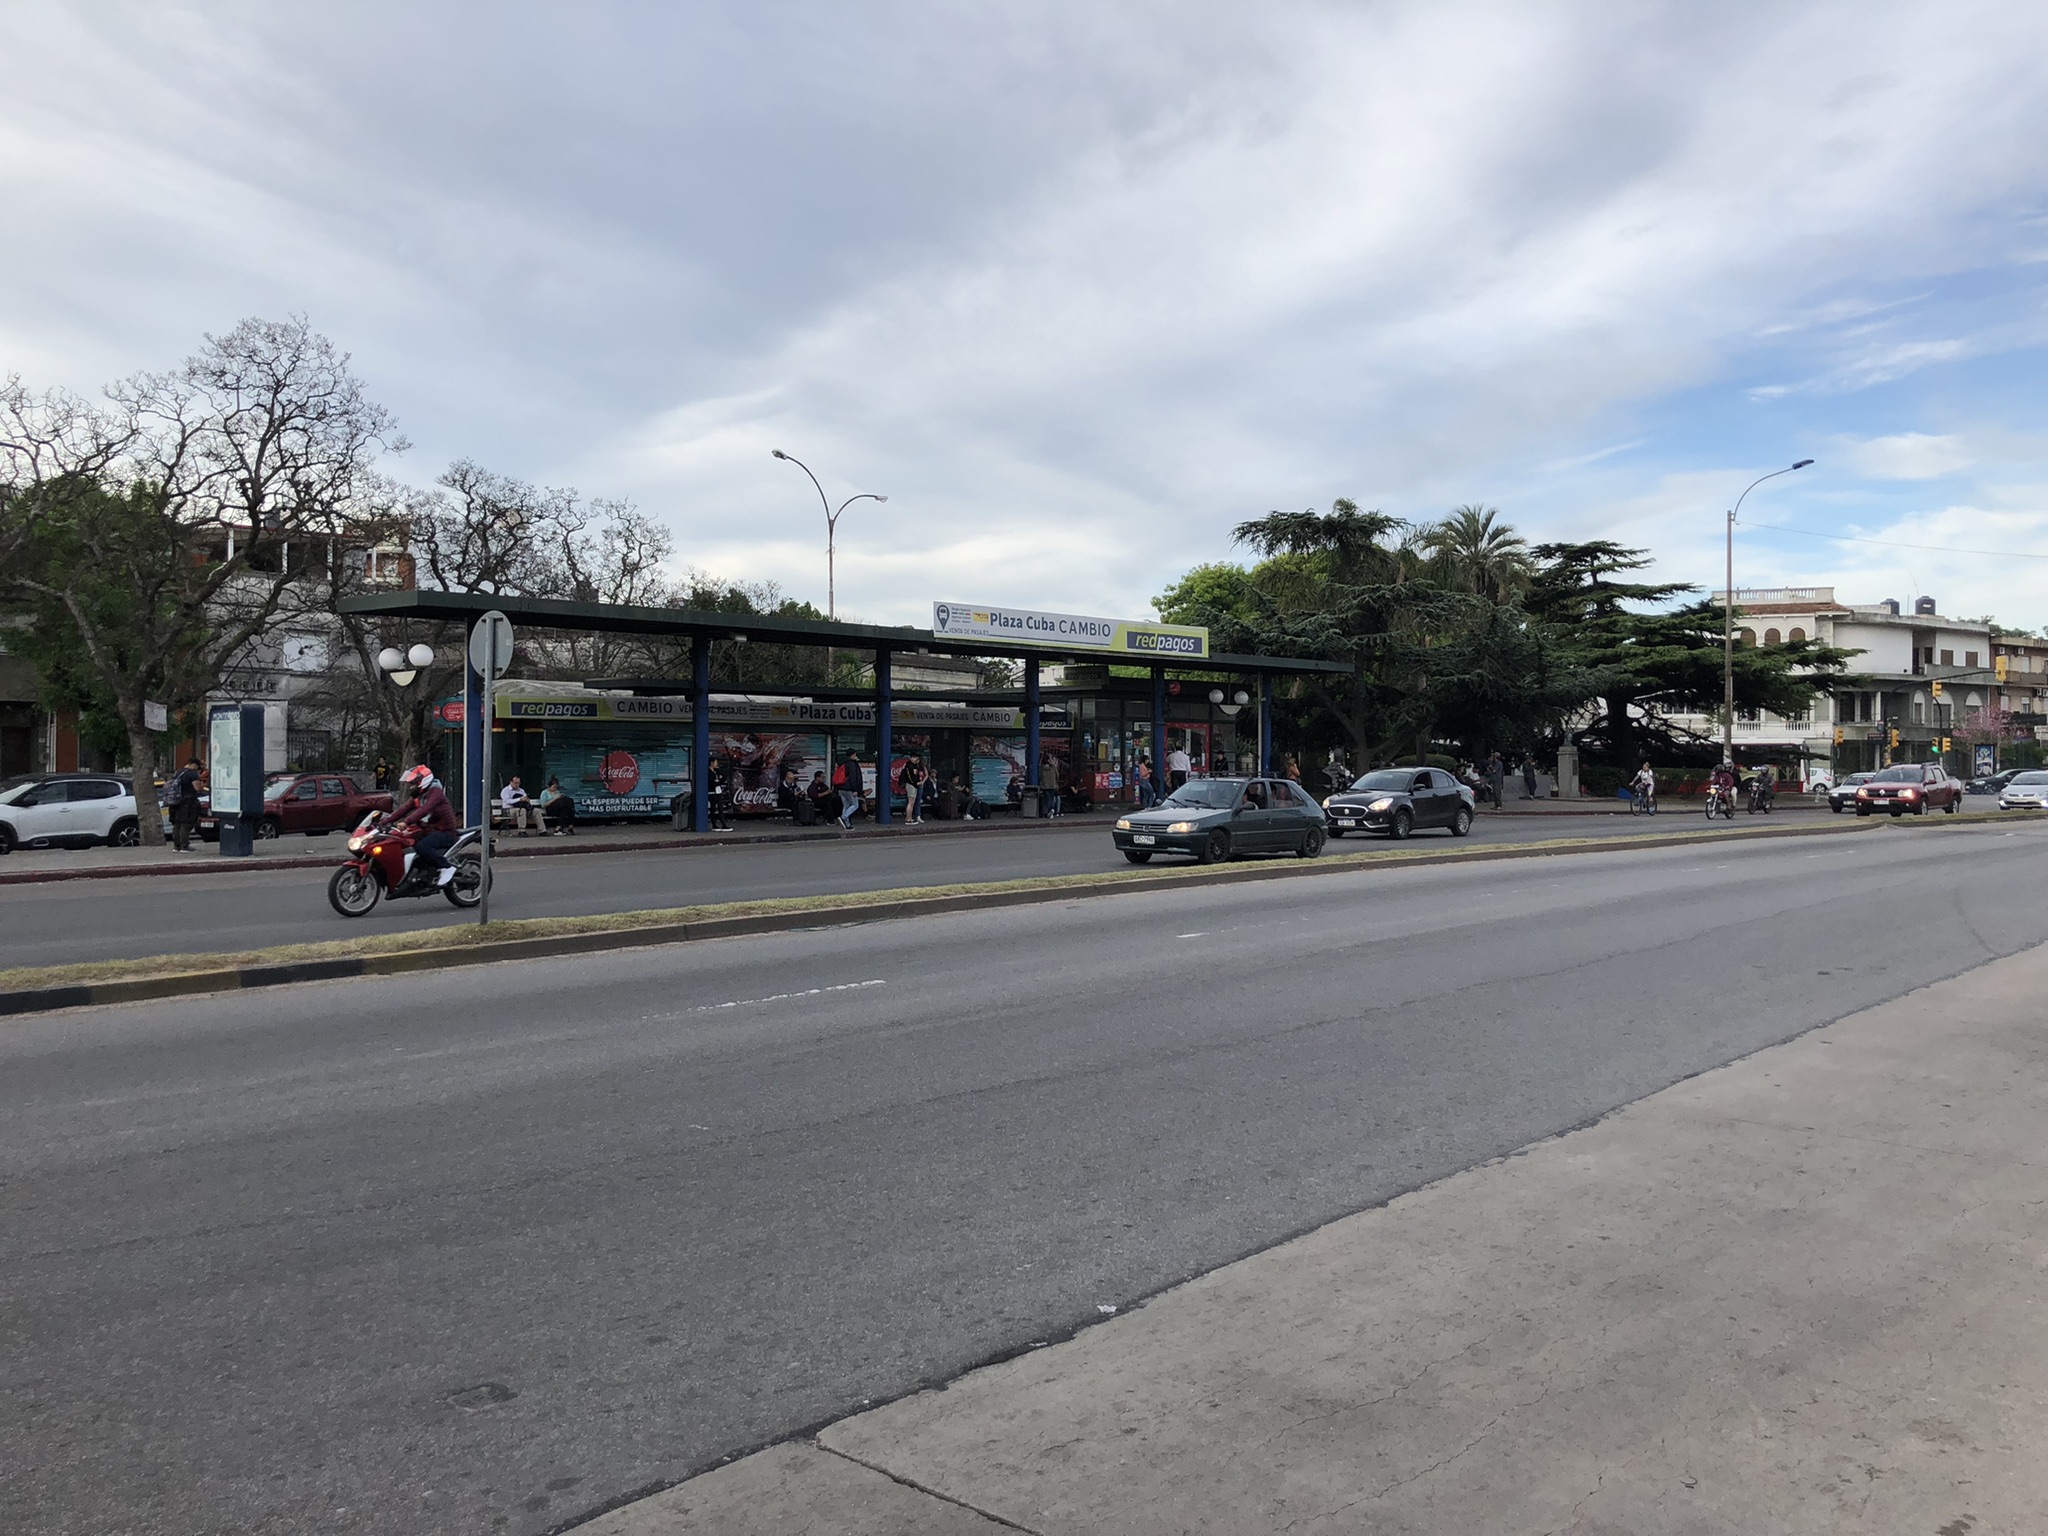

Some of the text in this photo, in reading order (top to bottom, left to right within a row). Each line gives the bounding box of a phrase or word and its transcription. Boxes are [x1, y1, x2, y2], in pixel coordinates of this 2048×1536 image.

[990, 612, 1022, 628] Plaza
[1026, 616, 1055, 631] Cuba
[1059, 620, 1112, 637] CAMBIO
[1135, 633, 1194, 652] redpagos
[521, 703, 588, 717] redpagos
[616, 701, 673, 713] CAMBIO
[678, 705, 693, 713] VEN
[716, 706, 747, 715] PASAJES
[800, 705, 836, 719] Plaza
[840, 707, 871, 720] Cuba
[936, 712, 944, 720] DE
[945, 712, 968, 720] PASAJES
[972, 712, 1010, 722] CAMBIO
